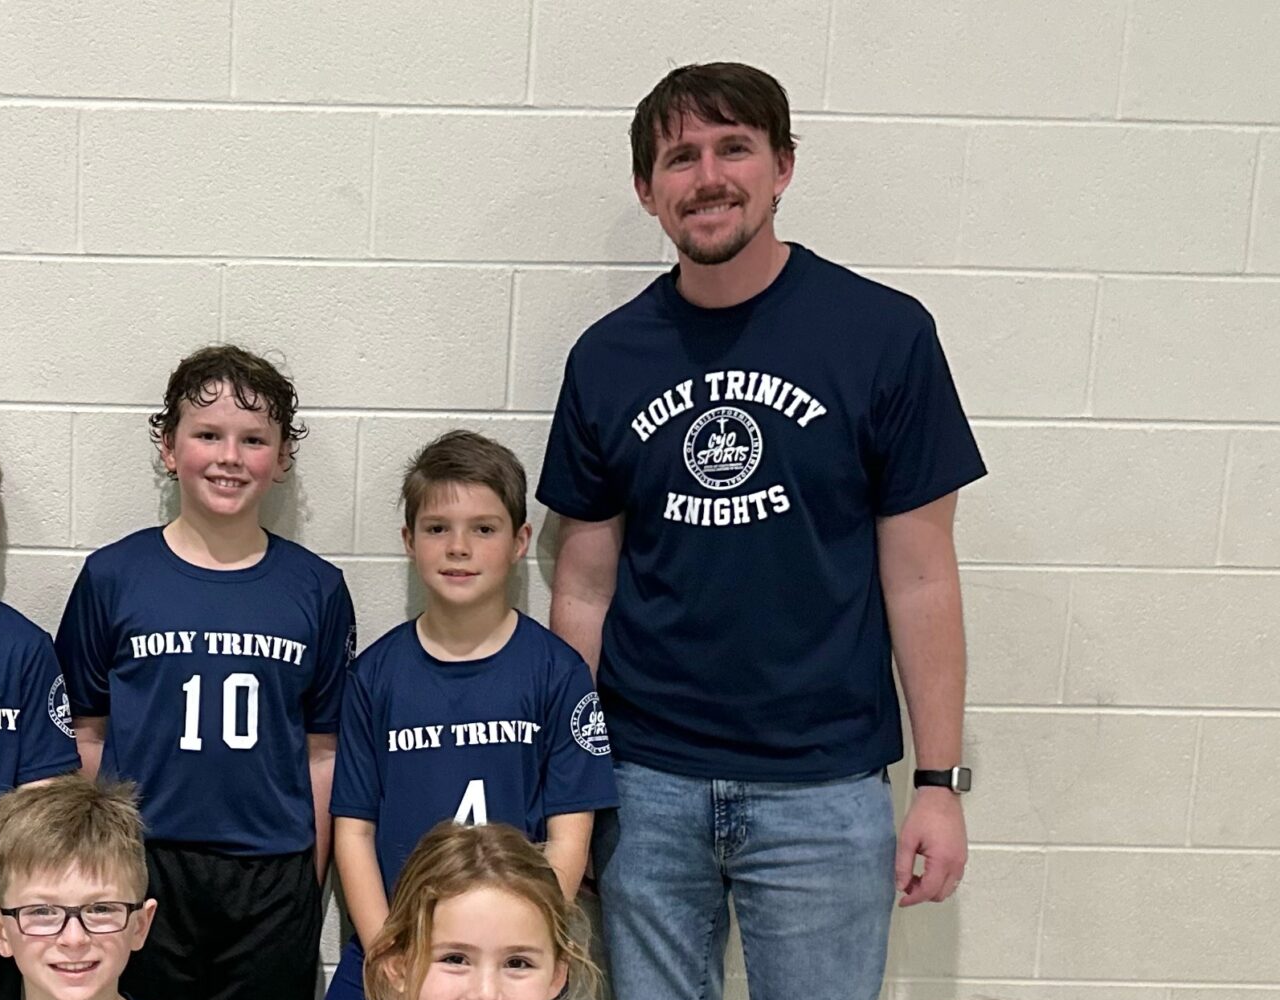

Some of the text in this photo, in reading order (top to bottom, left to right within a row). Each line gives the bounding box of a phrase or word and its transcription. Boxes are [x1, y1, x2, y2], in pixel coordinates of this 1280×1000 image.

[631, 370, 827, 443] HOLY TRINITY
[696, 446, 750, 465] SPORTS
[663, 484, 791, 527] KNIGHTS
[130, 630, 197, 659] HOLY
[204, 631, 307, 666] TRINITY
[179, 672, 261, 751] 10
